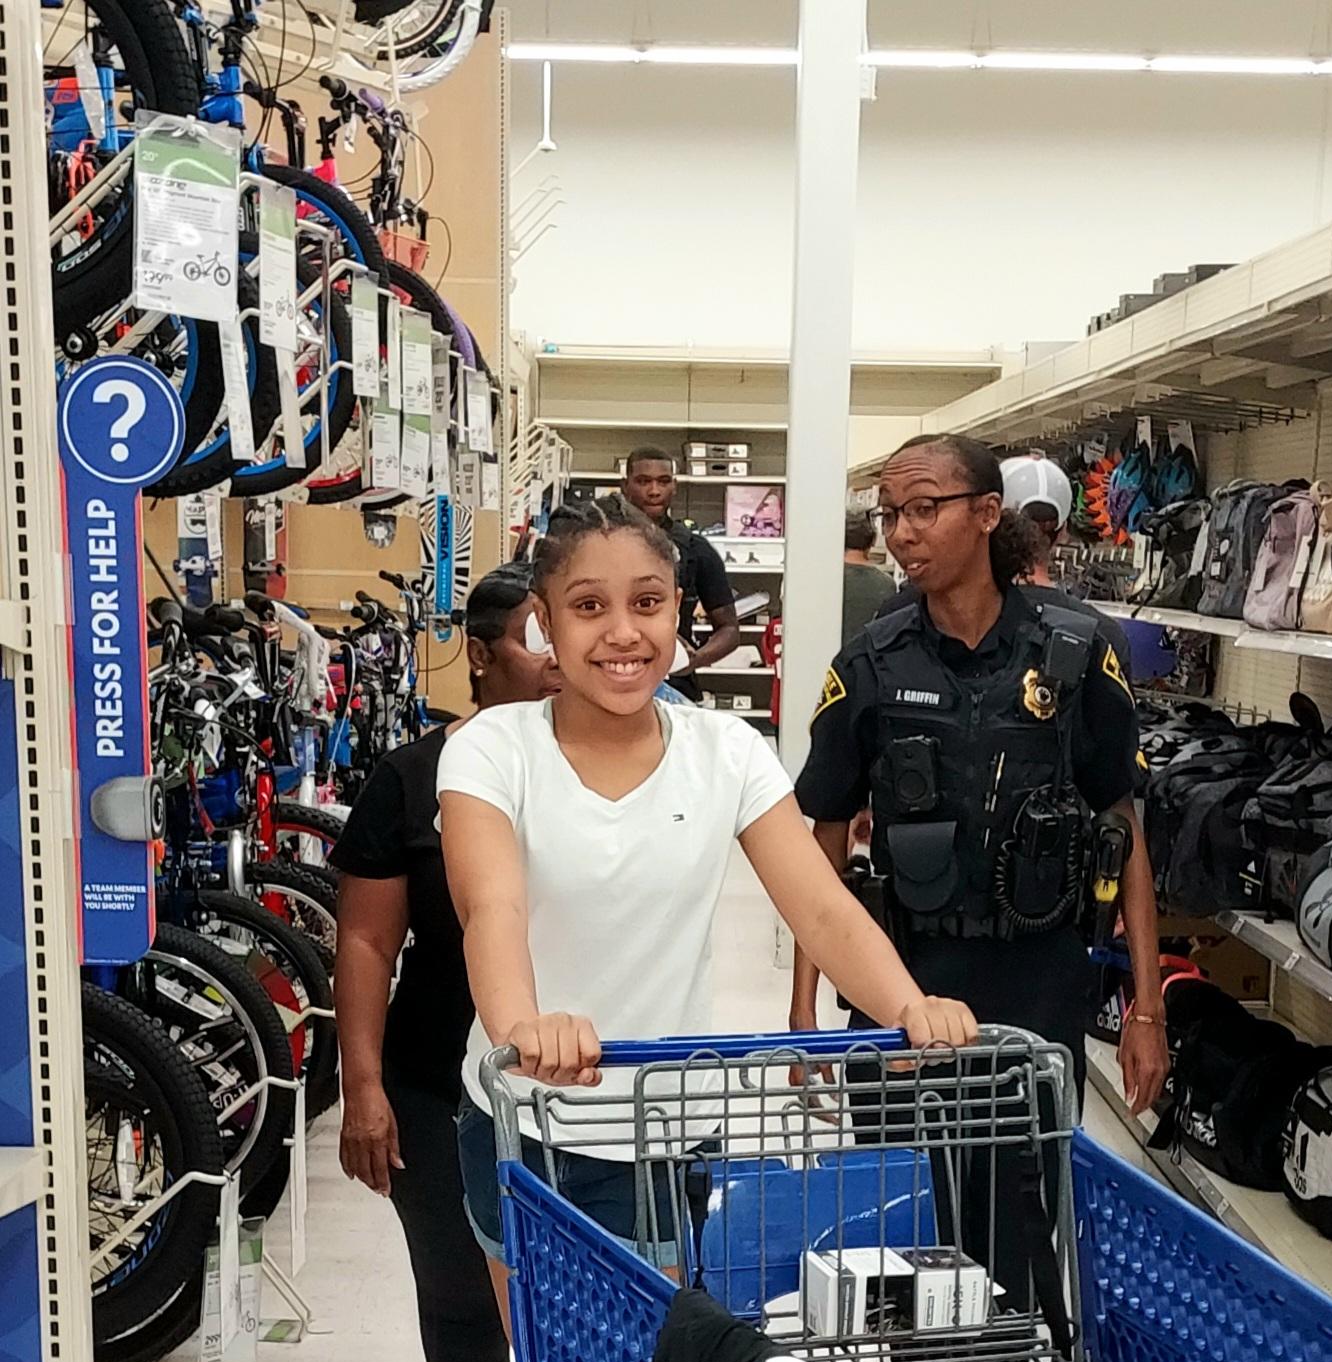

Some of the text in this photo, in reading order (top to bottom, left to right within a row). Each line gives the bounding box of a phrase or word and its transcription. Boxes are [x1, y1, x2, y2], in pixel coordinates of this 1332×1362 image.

[440, 499, 449, 560] VISION
[87, 499, 124, 757] PRESS FOR HELP
[903, 690, 940, 705] GRIFFIN
[84, 884, 146, 893] A TEAM MEMBER
[84, 893, 135, 902] WILL BE WITH
[102, 902, 135, 911] SHORTLY
